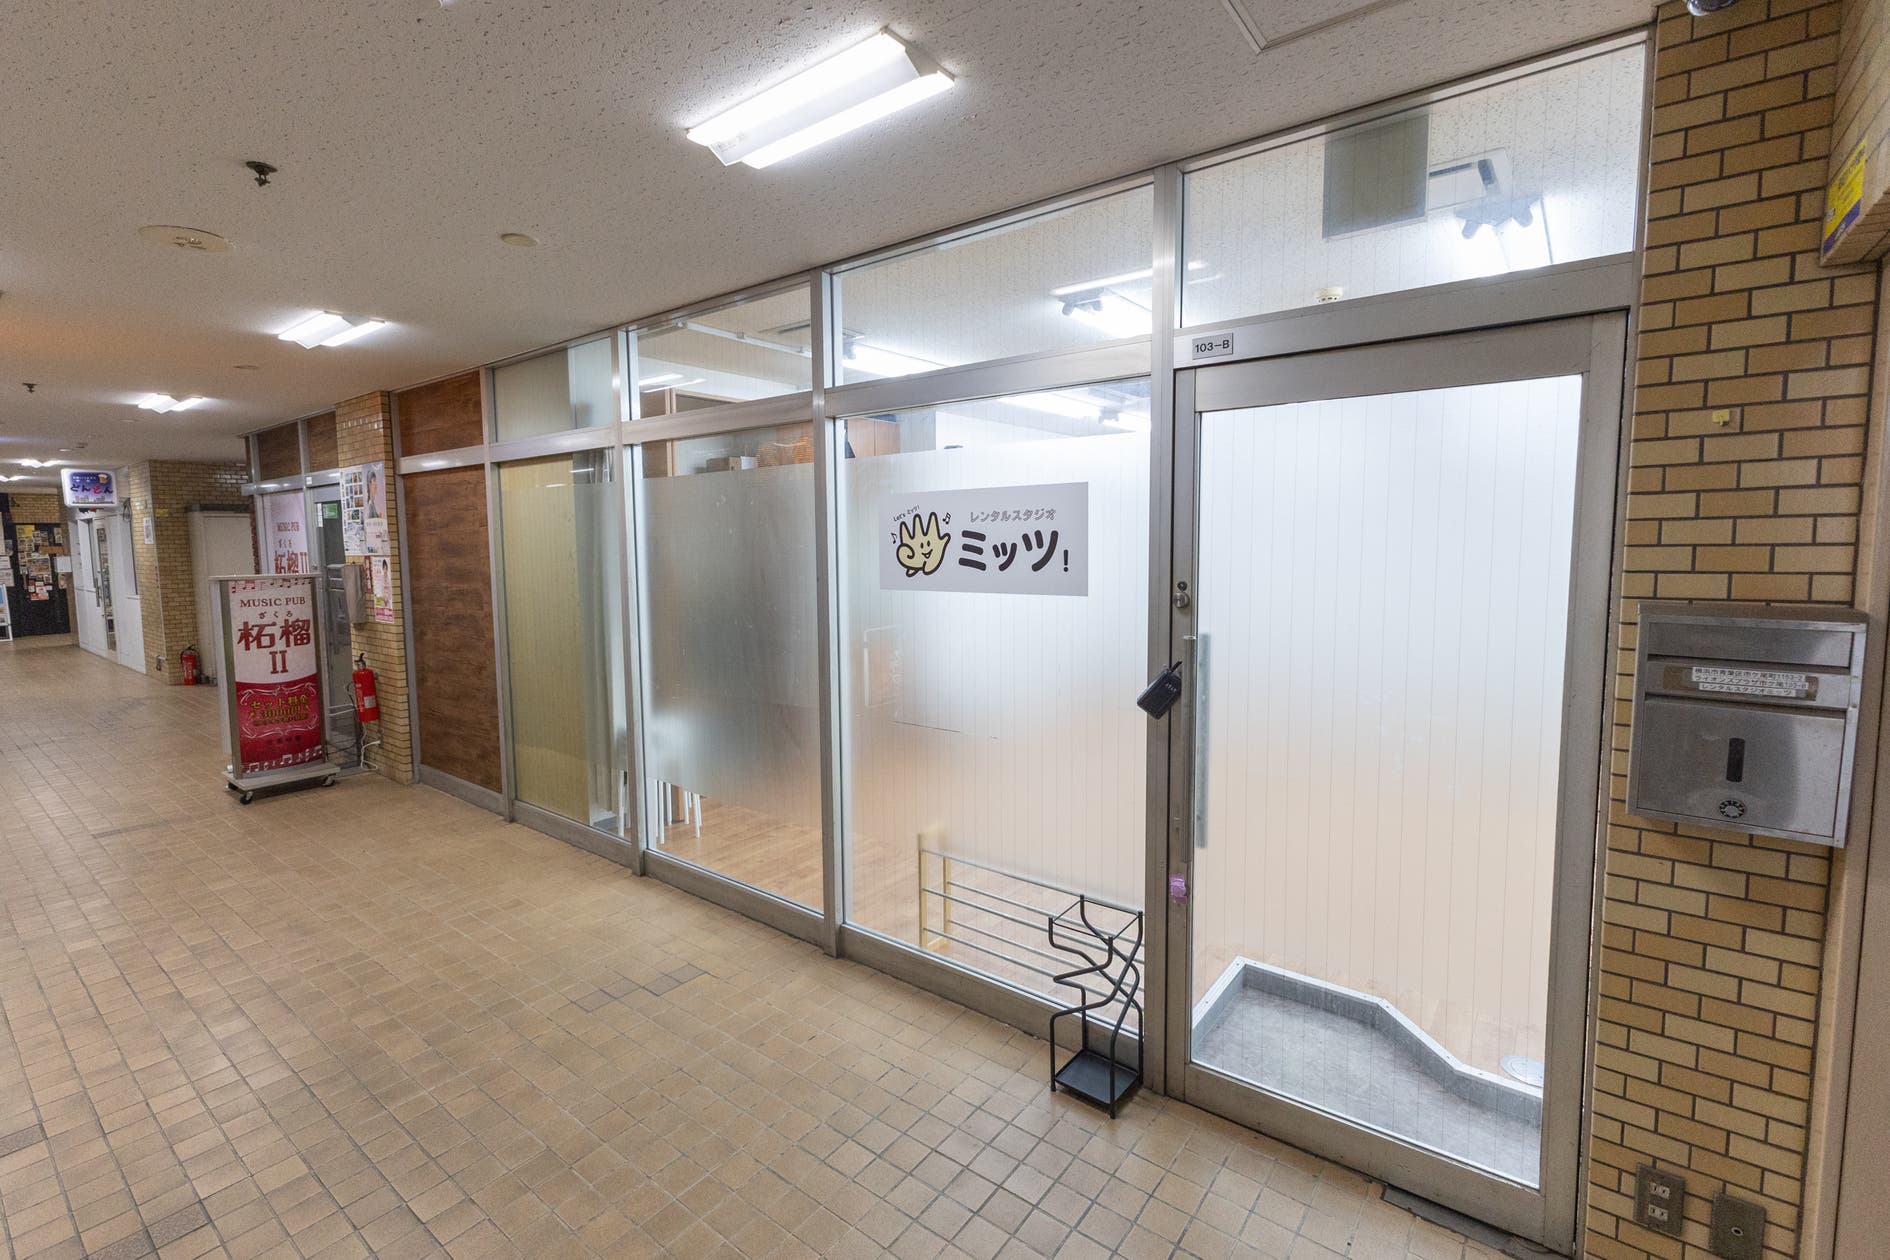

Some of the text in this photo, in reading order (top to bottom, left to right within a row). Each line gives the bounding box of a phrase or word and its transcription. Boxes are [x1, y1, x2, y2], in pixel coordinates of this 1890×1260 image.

[1195, 339, 1230, 353] 103-B
[969, 508, 1057, 523] レンタルスタジオ
[958, 529, 1069, 573] ミッツ!
[240, 596, 306, 608] MUSIC PUB
[258, 610, 293, 620] ざくろ
[237, 617, 311, 651] 柘榴
